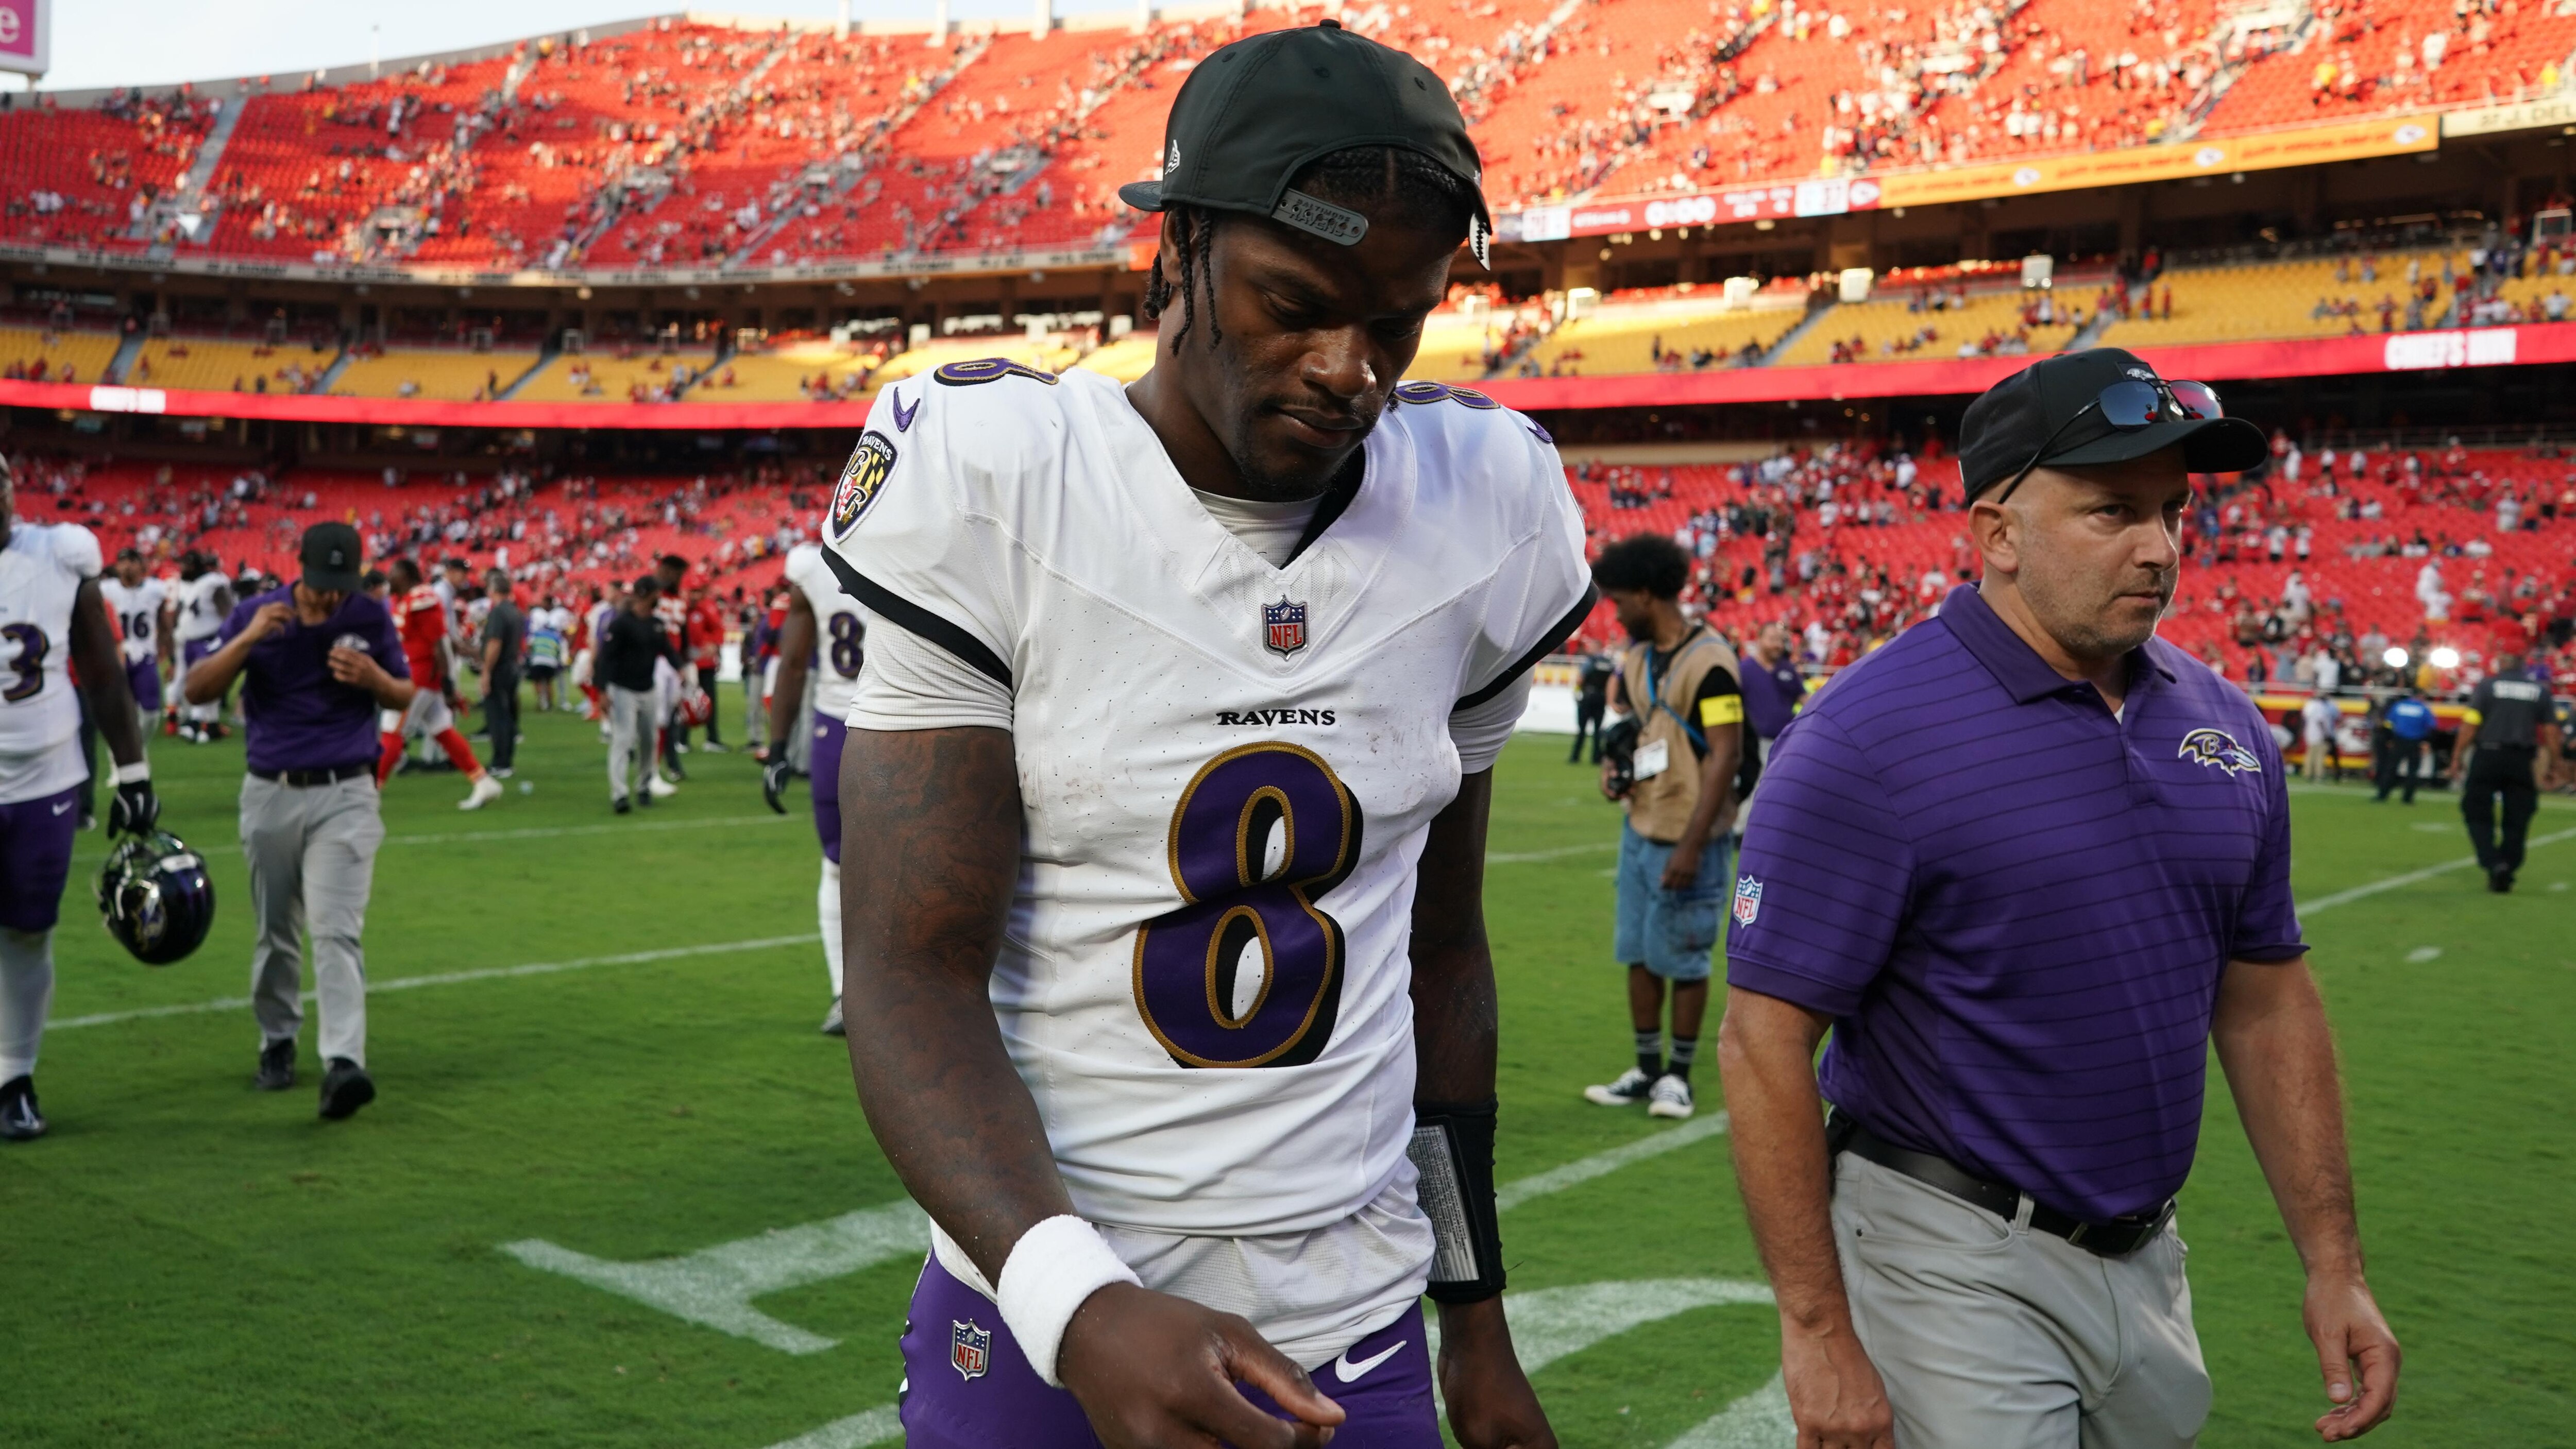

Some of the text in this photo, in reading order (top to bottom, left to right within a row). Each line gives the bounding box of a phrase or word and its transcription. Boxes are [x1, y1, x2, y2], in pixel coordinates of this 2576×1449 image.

[1296, 199, 1351, 222] BALTIMORE
[862, 435, 893, 461] RAVENS
[121, 611, 150, 639] 16
[1270, 624, 1302, 649] NFL
[1216, 709, 1336, 726] RAVENS
[1132, 741, 1363, 1069] 8
[1735, 897, 1754, 919] NFL
[956, 1344, 981, 1370] NFL
